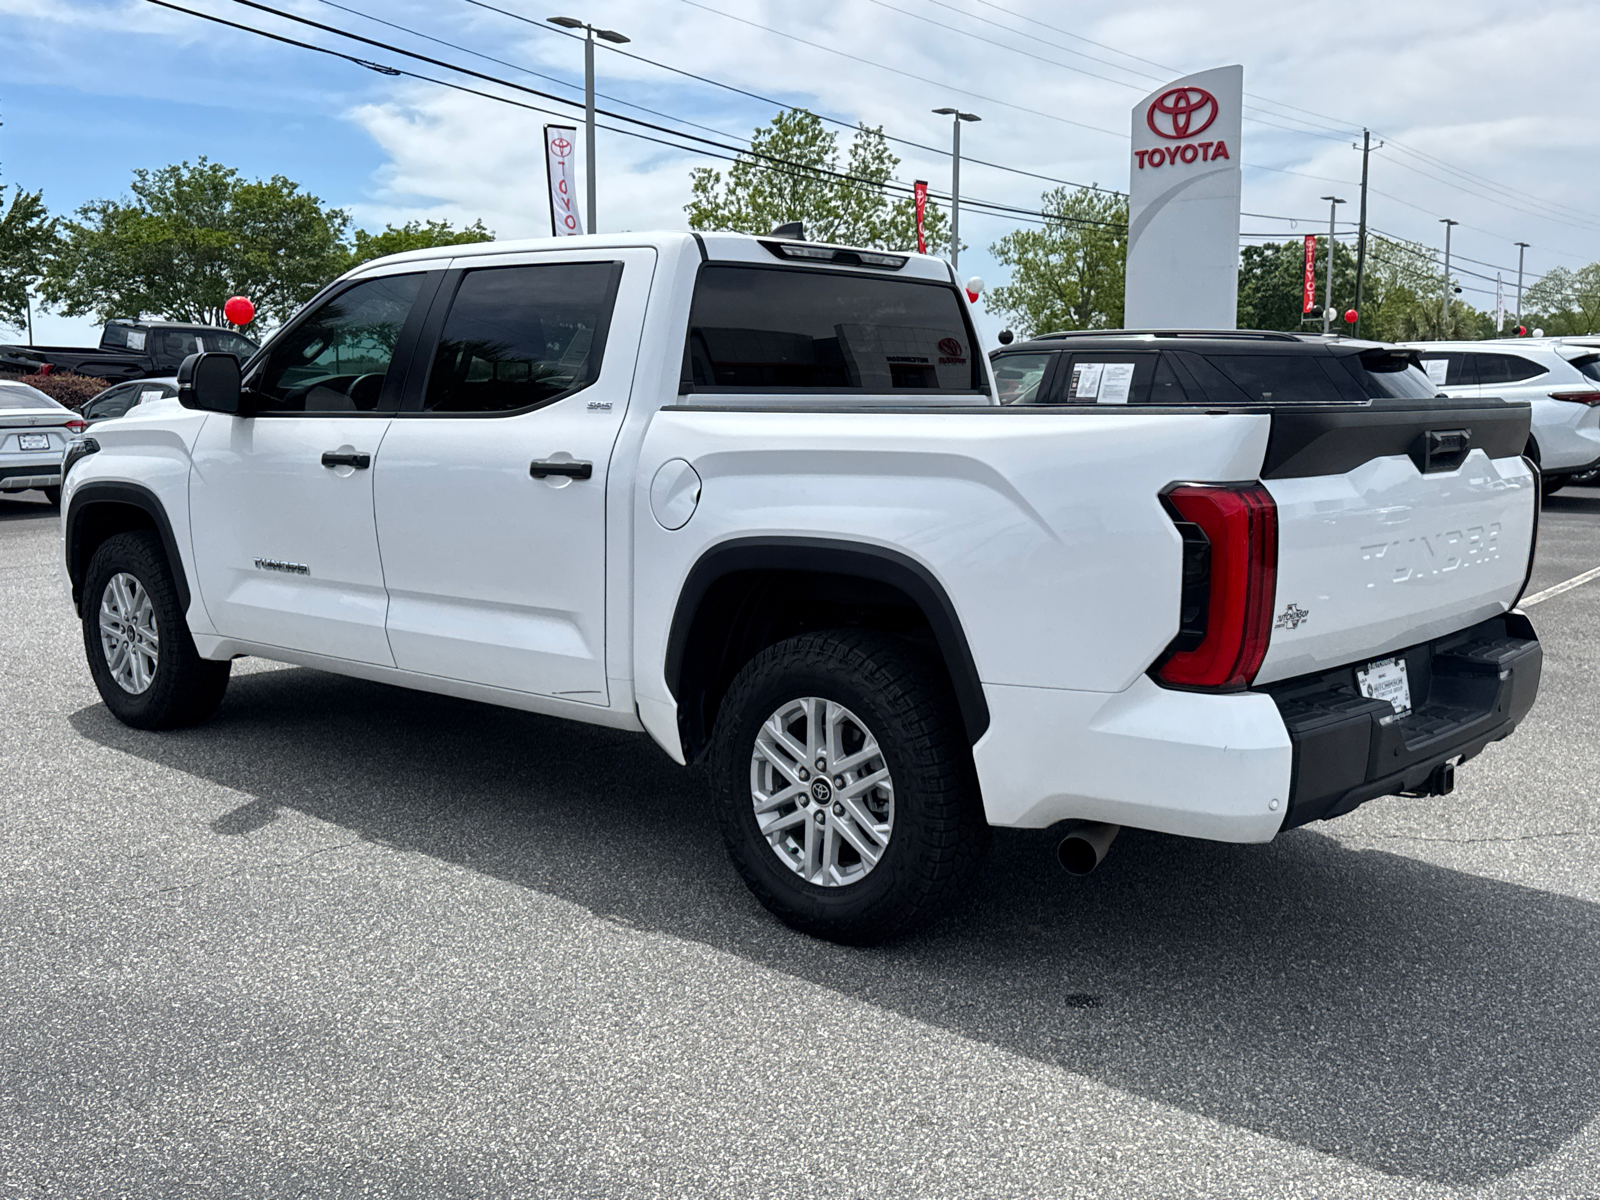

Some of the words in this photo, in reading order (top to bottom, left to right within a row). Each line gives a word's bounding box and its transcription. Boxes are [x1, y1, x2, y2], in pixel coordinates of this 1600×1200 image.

[1134, 140, 1230, 169] TOYOTA
[1306, 252, 1315, 310] TOYOTA
[253, 556, 311, 576] TUNDRA
[1360, 521, 1502, 588] TUNDRA
